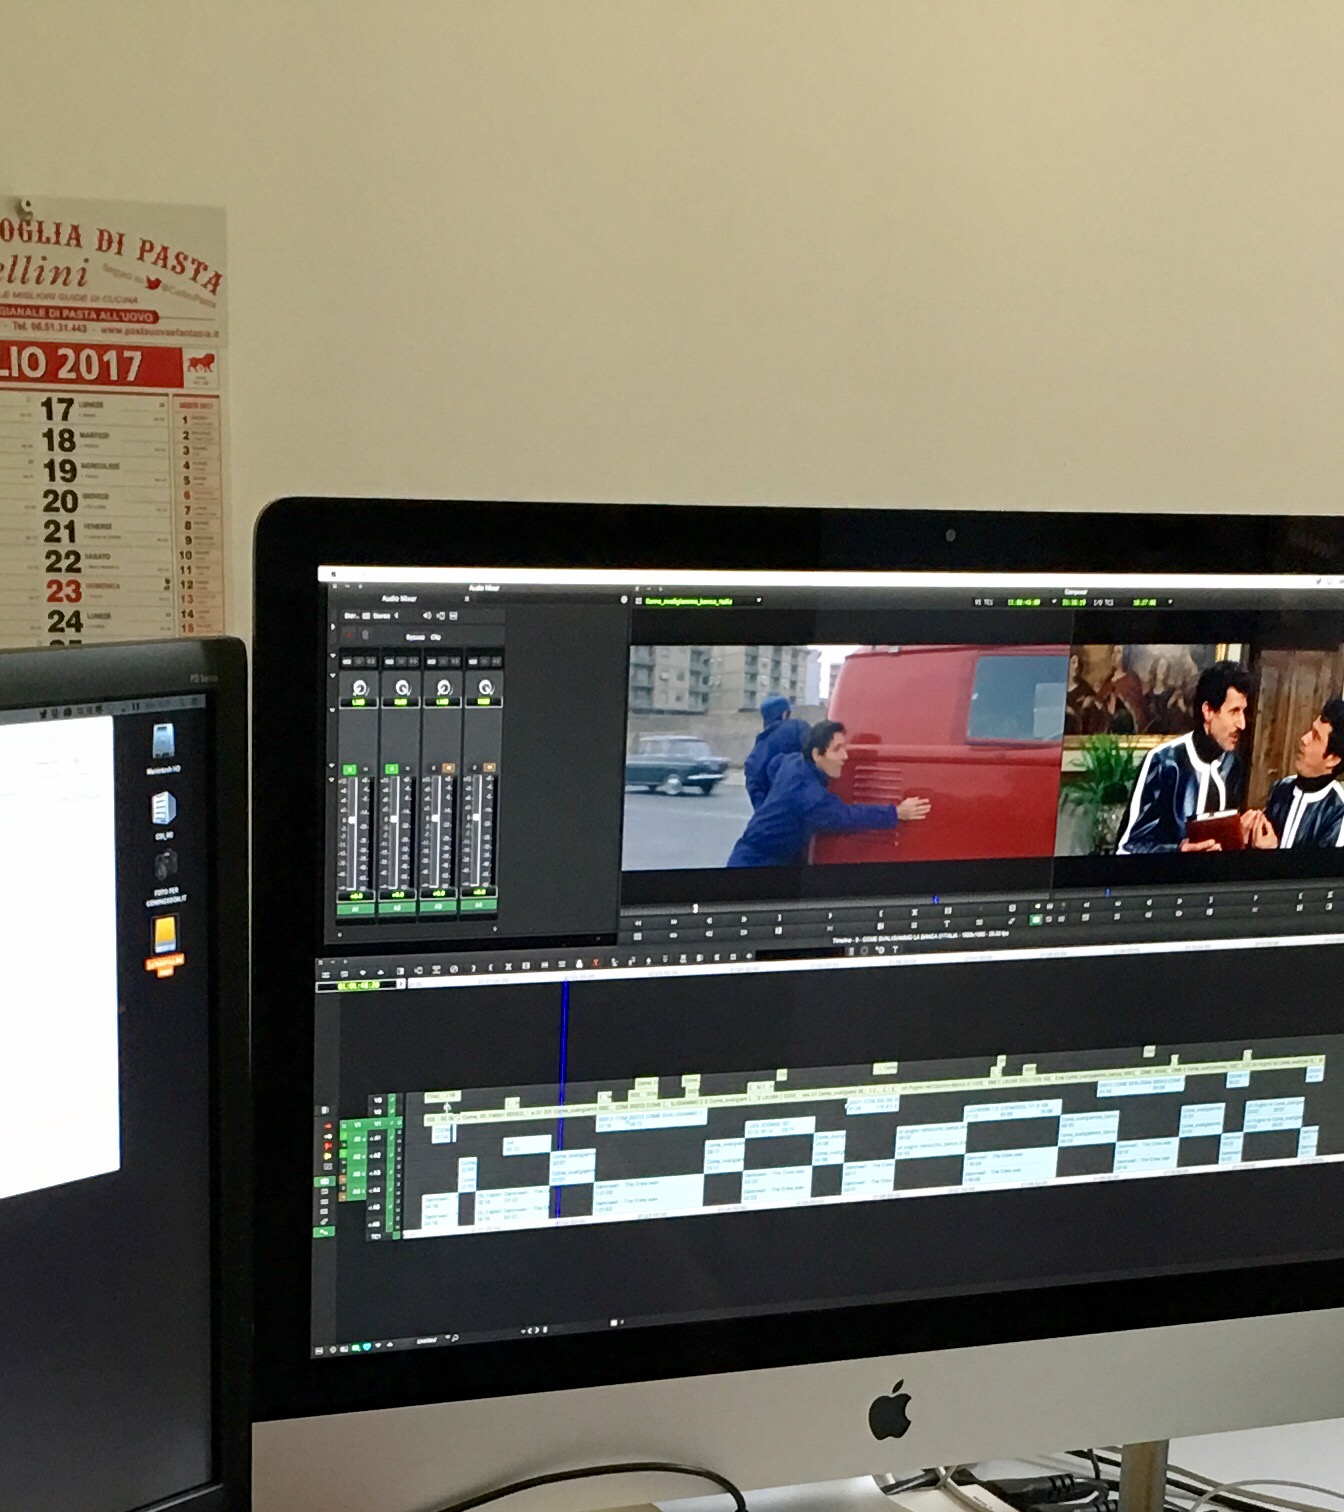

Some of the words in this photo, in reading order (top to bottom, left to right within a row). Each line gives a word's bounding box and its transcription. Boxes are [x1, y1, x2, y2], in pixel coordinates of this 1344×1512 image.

[96, 227, 126, 256] DI
[137, 237, 224, 296] PASTA
[103, 294, 138, 304] CUCINA
[48, 309, 61, 318] DI
[62, 309, 97, 320] PASTA
[99, 310, 154, 322] ALL'UOVO
[57, 348, 143, 382] 2017
[41, 396, 75, 421] 17
[182, 415, 188, 425] 1
[42, 427, 76, 452] 18
[182, 431, 190, 440] 2
[183, 446, 190, 455] 3
[43, 458, 77, 483] 19
[183, 461, 191, 470] 4
[184, 476, 191, 486] 5
[184, 491, 191, 500] 6
[42, 489, 79, 513] 20
[184, 506, 192, 516] 7
[43, 519, 76, 543] 21
[184, 521, 192, 531] 8
[185, 536, 193, 545] 9
[179, 550, 192, 560] 10
[45, 549, 82, 574] 22
[179, 565, 192, 575] 11
[180, 580, 193, 590] 12
[46, 579, 82, 604] 23
[181, 594, 194, 604] 13
[181, 609, 194, 619] 14
[47, 609, 84, 633] 24
[181, 624, 194, 633] 15
